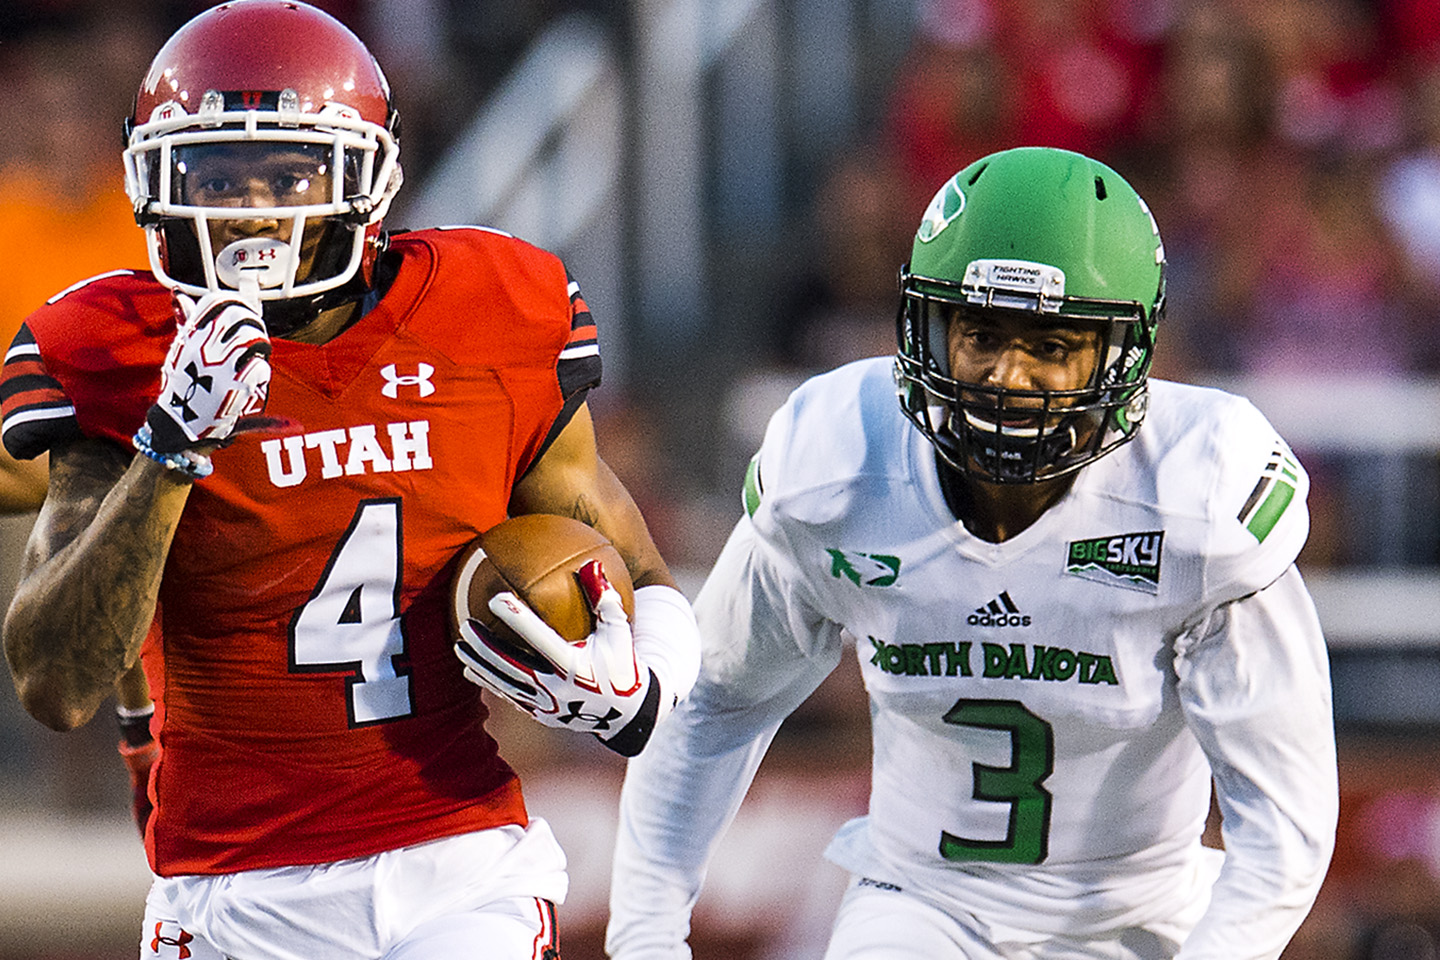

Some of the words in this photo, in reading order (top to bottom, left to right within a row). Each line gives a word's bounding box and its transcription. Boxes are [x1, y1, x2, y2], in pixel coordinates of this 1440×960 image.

[993, 265, 1041, 276] FIGHTING
[996, 275, 1037, 284] HAWKS
[260, 419, 434, 488] UTAH
[287, 497, 417, 729] 4
[967, 614, 1032, 627] adidas
[868, 635, 973, 677] NORTH
[981, 642, 1119, 686] DAKOTA
[938, 697, 1054, 865] 3
